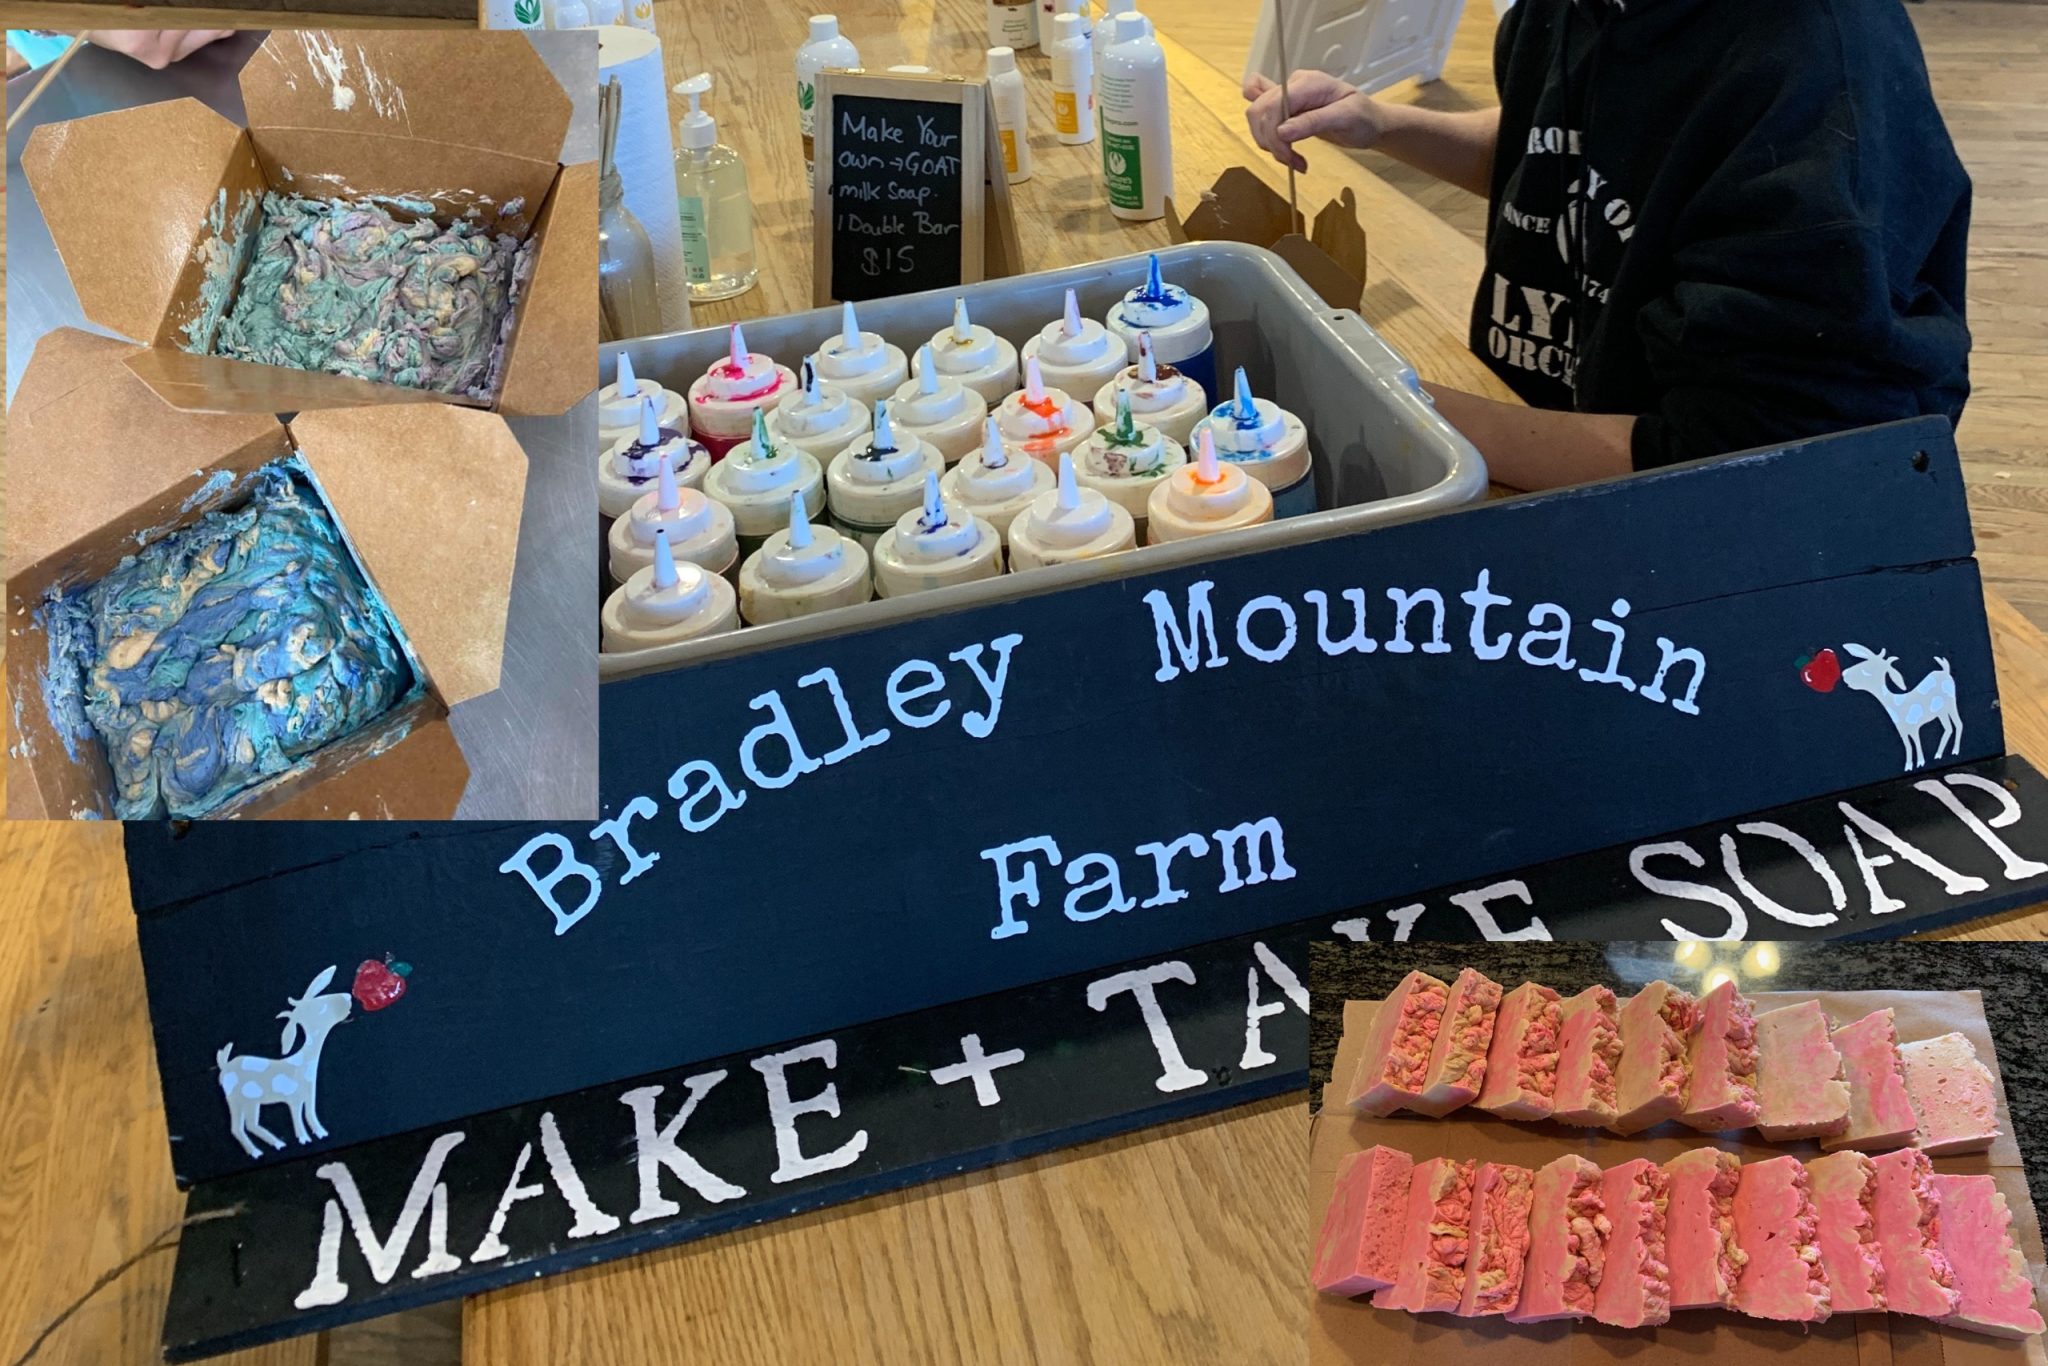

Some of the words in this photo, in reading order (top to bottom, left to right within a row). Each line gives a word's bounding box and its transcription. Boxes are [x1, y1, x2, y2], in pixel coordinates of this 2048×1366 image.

[842, 112, 904, 144] Make
[917, 115, 958, 147] Your
[838, 151, 885, 169] own
[905, 152, 961, 177] GOAT
[839, 181, 881, 202] milk
[849, 214, 905, 236] Double
[913, 212, 960, 235] Bar
[861, 245, 915, 276] $15
[499, 633, 1023, 936] Bradley
[1143, 568, 1706, 715] Mountain
[980, 816, 1297, 940] Farm
[294, 1038, 869, 1310] MAKE
[1629, 773, 2048, 942] SOAP
